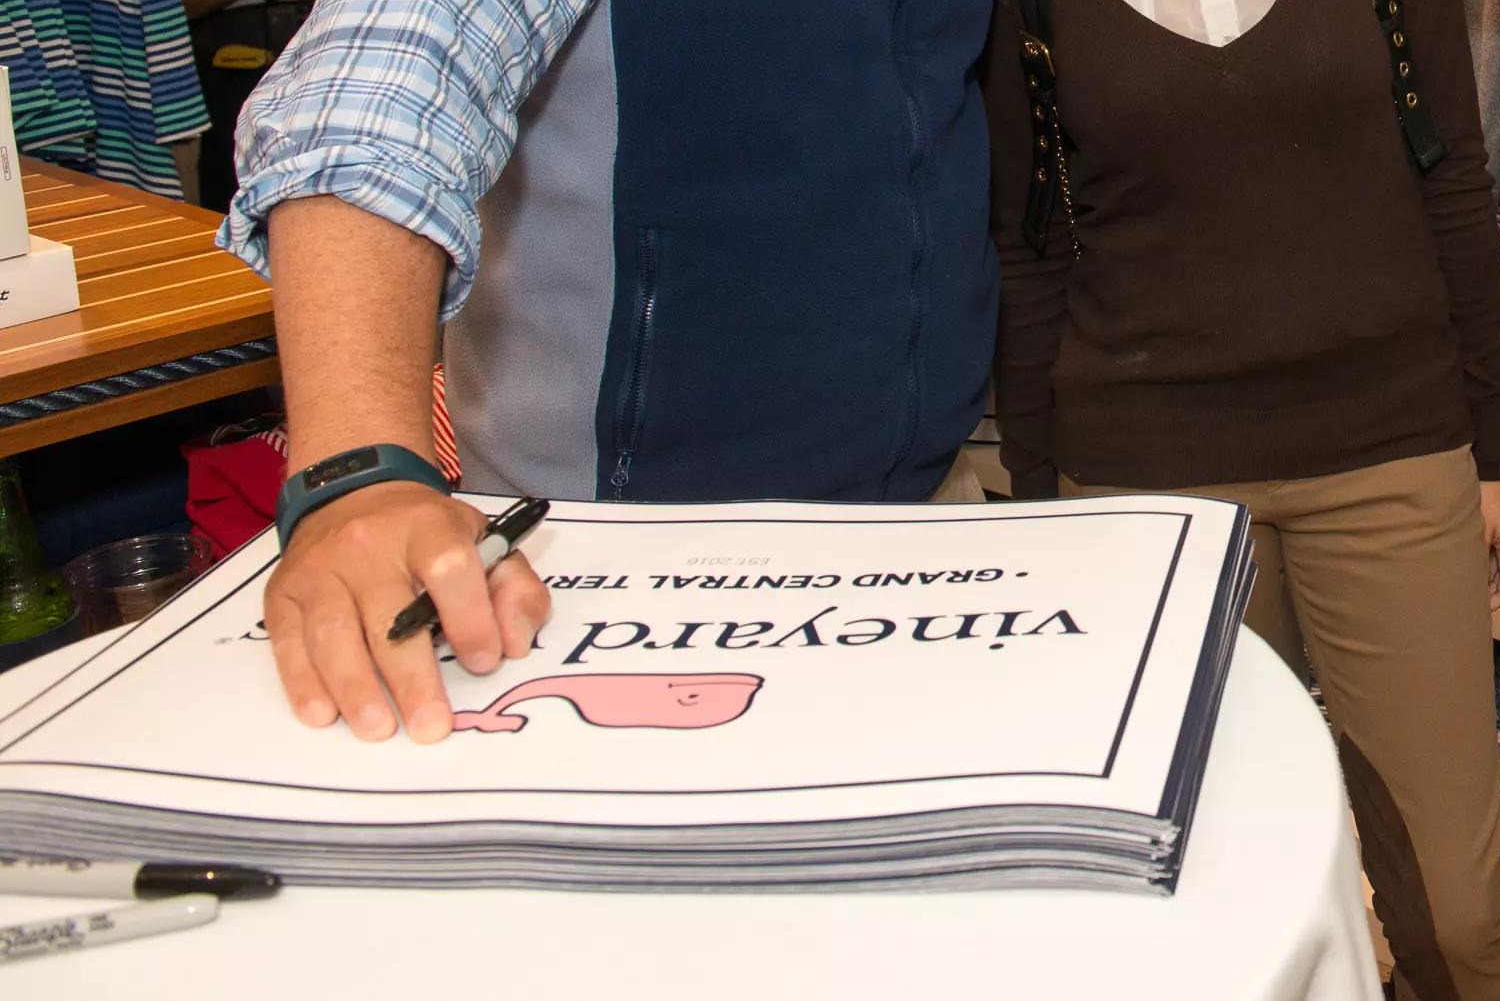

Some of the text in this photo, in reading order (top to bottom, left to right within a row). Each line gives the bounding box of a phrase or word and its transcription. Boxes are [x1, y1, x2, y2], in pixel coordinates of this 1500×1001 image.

[685, 556, 734, 567] 2016
[648, 574, 842, 589] CENTRAL
[851, 568, 1005, 588] GRAND
[561, 605, 1089, 665] vineyard
